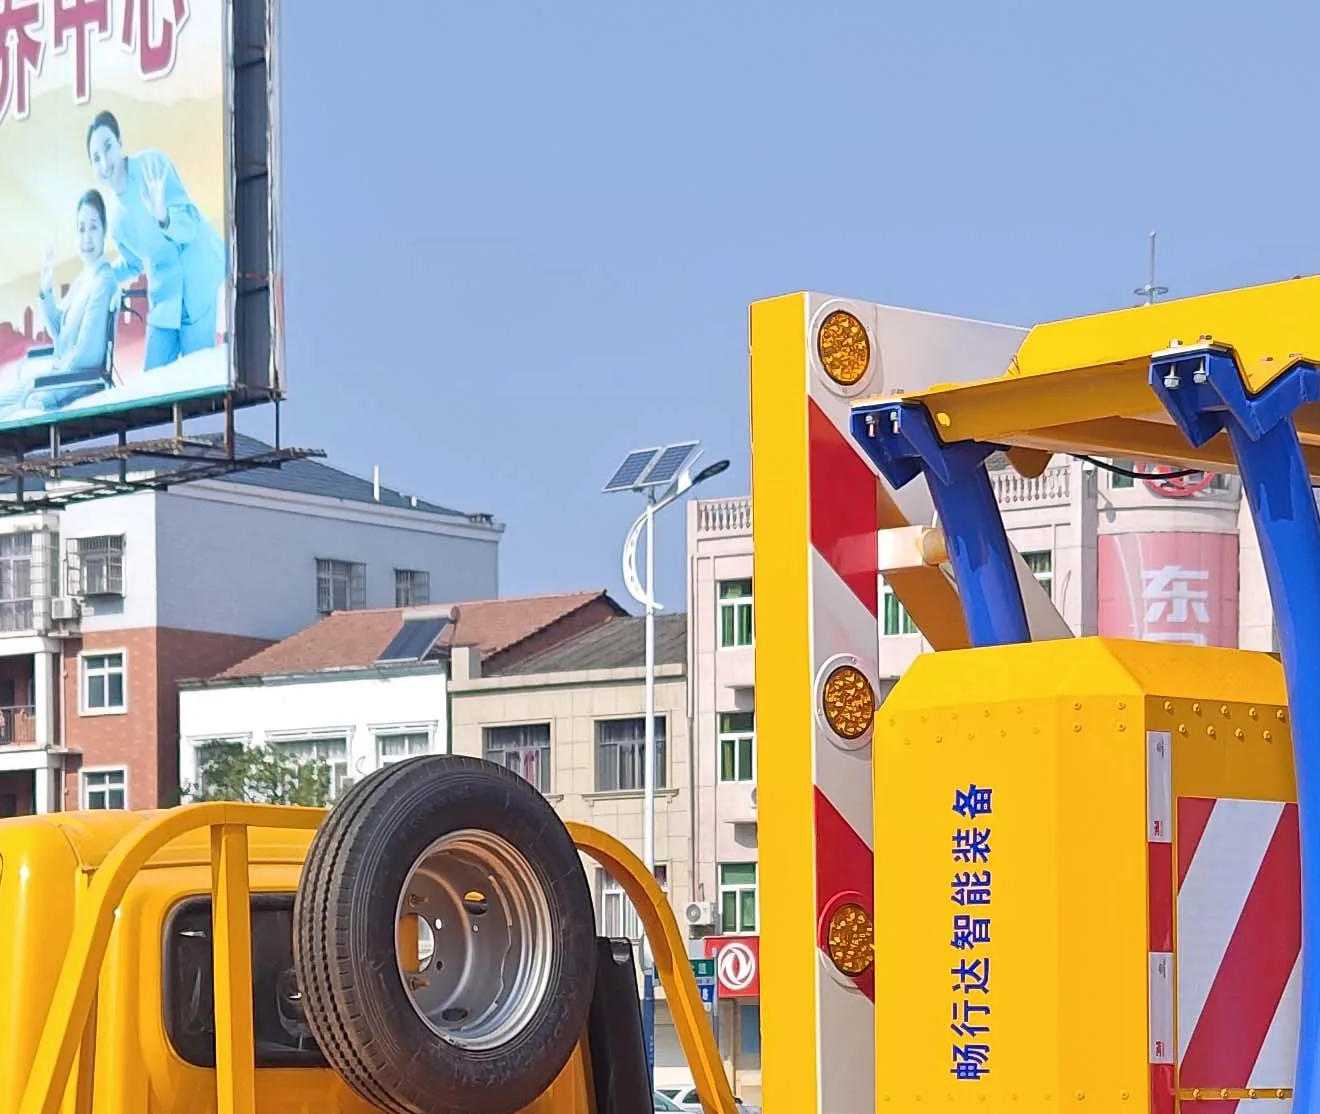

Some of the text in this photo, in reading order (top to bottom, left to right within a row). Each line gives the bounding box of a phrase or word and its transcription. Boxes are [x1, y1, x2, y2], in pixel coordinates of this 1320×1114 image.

[1141, 564, 1211, 646] 东
[950, 783, 993, 1080] 畅行达智能装备
